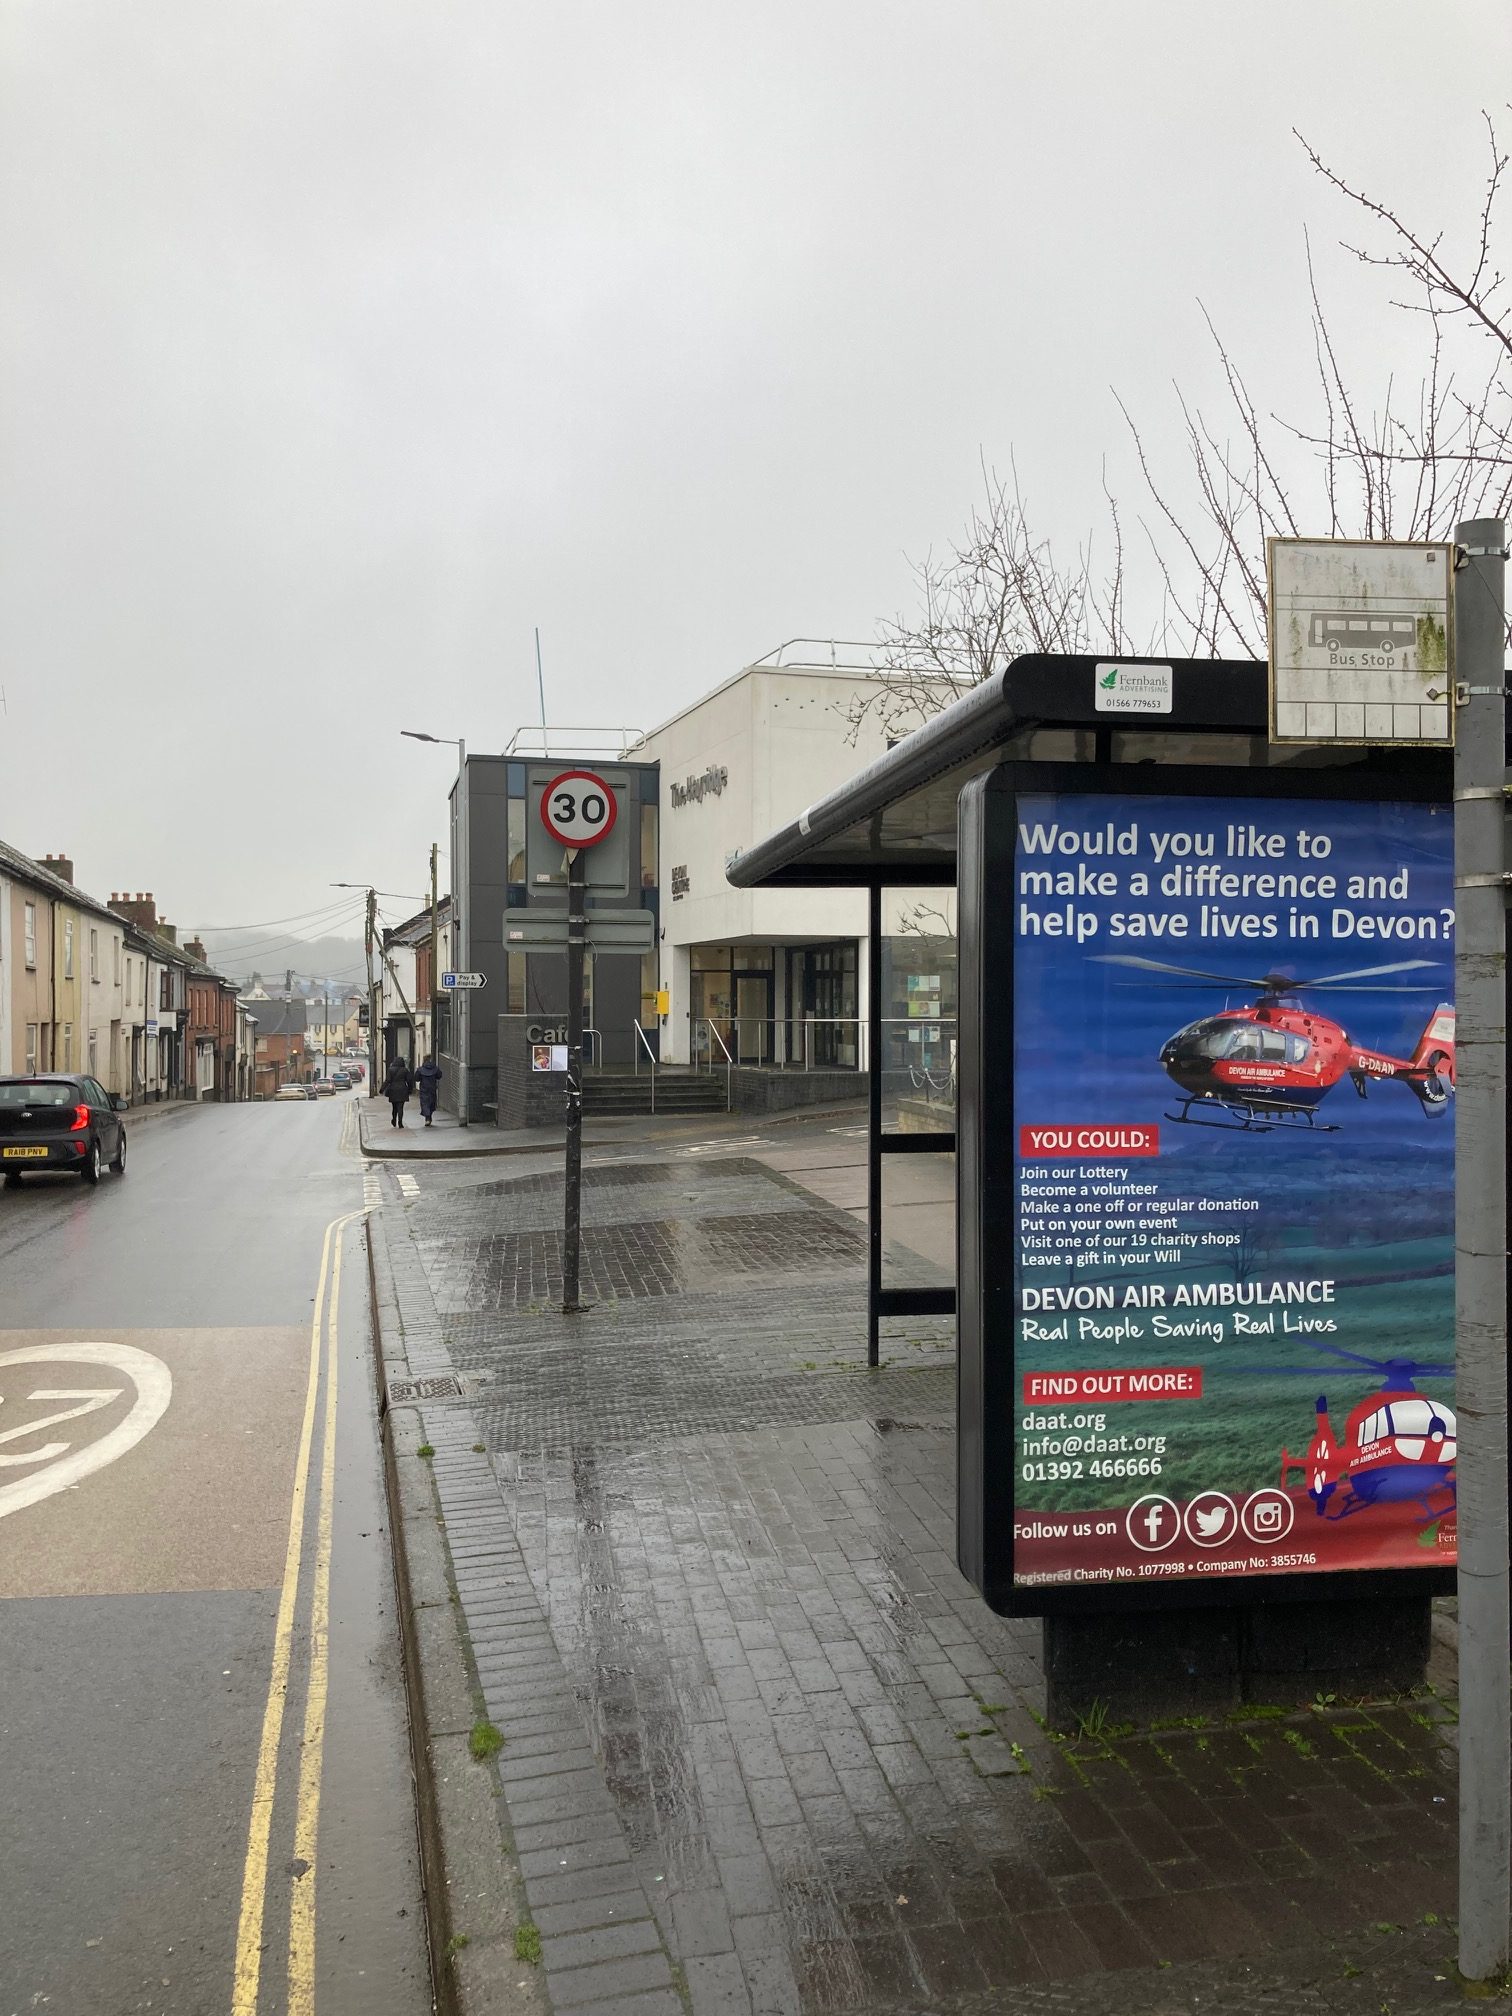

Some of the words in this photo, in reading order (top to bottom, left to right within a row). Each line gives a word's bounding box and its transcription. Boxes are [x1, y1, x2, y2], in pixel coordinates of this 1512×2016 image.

[1330, 653, 1355, 665] Bus
[1361, 653, 1395, 668] Stop
[1120, 675, 1168, 686] Fernbank
[1106, 699, 1130, 707] 01566
[1133, 700, 1161, 708] 779653
[553, 794, 605, 824] 30
[1019, 823, 1138, 855] Would
[1150, 832, 1215, 863] you
[1227, 825, 1286, 857] like
[1296, 830, 1332, 858] to
[1020, 863, 1118, 896] make
[1129, 872, 1149, 896] a
[1161, 865, 1336, 898] difference
[1346, 868, 1409, 900] and
[1020, 903, 1098, 943] help
[1110, 913, 1189, 937] save
[1201, 905, 1278, 938] lives
[1289, 907, 1319, 938] in
[1332, 908, 1456, 940] Devon?
[1229, 1066, 1246, 1076] DEVON
[1358, 1055, 1395, 1075] G-DAAN
[1031, 1131, 1073, 1148] YOU
[1077, 1131, 1150, 1148] COULD:
[1020, 1166, 1048, 1179] Join
[1052, 1168, 1076, 1179] our
[1080, 1166, 1128, 1181] Lottery
[1021, 1184, 1076, 1196] Become
[1080, 1186, 1088, 1196] a
[1092, 1182, 1158, 1195] volunteer
[1021, 1201, 1059, 1214] Make
[1063, 1203, 1071, 1213] a
[1075, 1203, 1101, 1213] one
[1105, 1200, 1124, 1213] off
[1127, 1202, 1142, 1212] or
[1146, 1198, 1194, 1215] regular
[1198, 1198, 1259, 1211] donation
[1021, 1218, 1044, 1231] Put
[1048, 1221, 1066, 1231] on
[1070, 1219, 1101, 1233] your
[1105, 1220, 1135, 1230] own
[1139, 1217, 1178, 1229] event
[1021, 1235, 1051, 1248] Visit
[1055, 1237, 1082, 1247] one
[1085, 1234, 1100, 1247] of
[1103, 1236, 1127, 1246] our
[1131, 1234, 1147, 1246] 19
[1150, 1233, 1198, 1248] charity
[1201, 1232, 1241, 1247] shops
[1022, 1253, 1061, 1266] Leave
[1065, 1255, 1073, 1265] a
[1076, 1252, 1100, 1267] gift
[1103, 1252, 1116, 1264] in
[1119, 1253, 1151, 1267] your
[1154, 1249, 1181, 1263] Will
[1022, 1286, 1115, 1311] DEVON
[1122, 1285, 1166, 1308] AIR
[1172, 1280, 1335, 1307] AMBULANCE
[1020, 1317, 1069, 1341] Real
[1078, 1316, 1144, 1345] People
[1151, 1315, 1224, 1344] Saving
[1232, 1311, 1275, 1335] Real
[1282, 1310, 1338, 1333] Lives
[1031, 1378, 1078, 1396] FIND
[1082, 1376, 1125, 1394] OUT
[1129, 1373, 1194, 1392] MORE:
[1022, 1412, 1106, 1431] daat.org
[1022, 1435, 1167, 1457] info@daat.org
[1361, 1442, 1380, 1454] DEVON
[1349, 1459, 1360, 1467] AIR
[1360, 1446, 1392, 1464] AMBULANCE
[1022, 1461, 1084, 1482] 01392
[1089, 1457, 1163, 1478] 466666
[1014, 1522, 1068, 1540] Follow
[1072, 1524, 1092, 1536] us
[1096, 1521, 1117, 1535] on
[1014, 1570, 1072, 1586] Registered
[1074, 1567, 1114, 1582] Charity
[1117, 1566, 1136, 1577] No.
[1138, 1563, 1185, 1576] 1077998
[1196, 1558, 1247, 1572] Company
[1250, 1557, 1269, 1568] No:
[1271, 1553, 1316, 1566] 3855746
